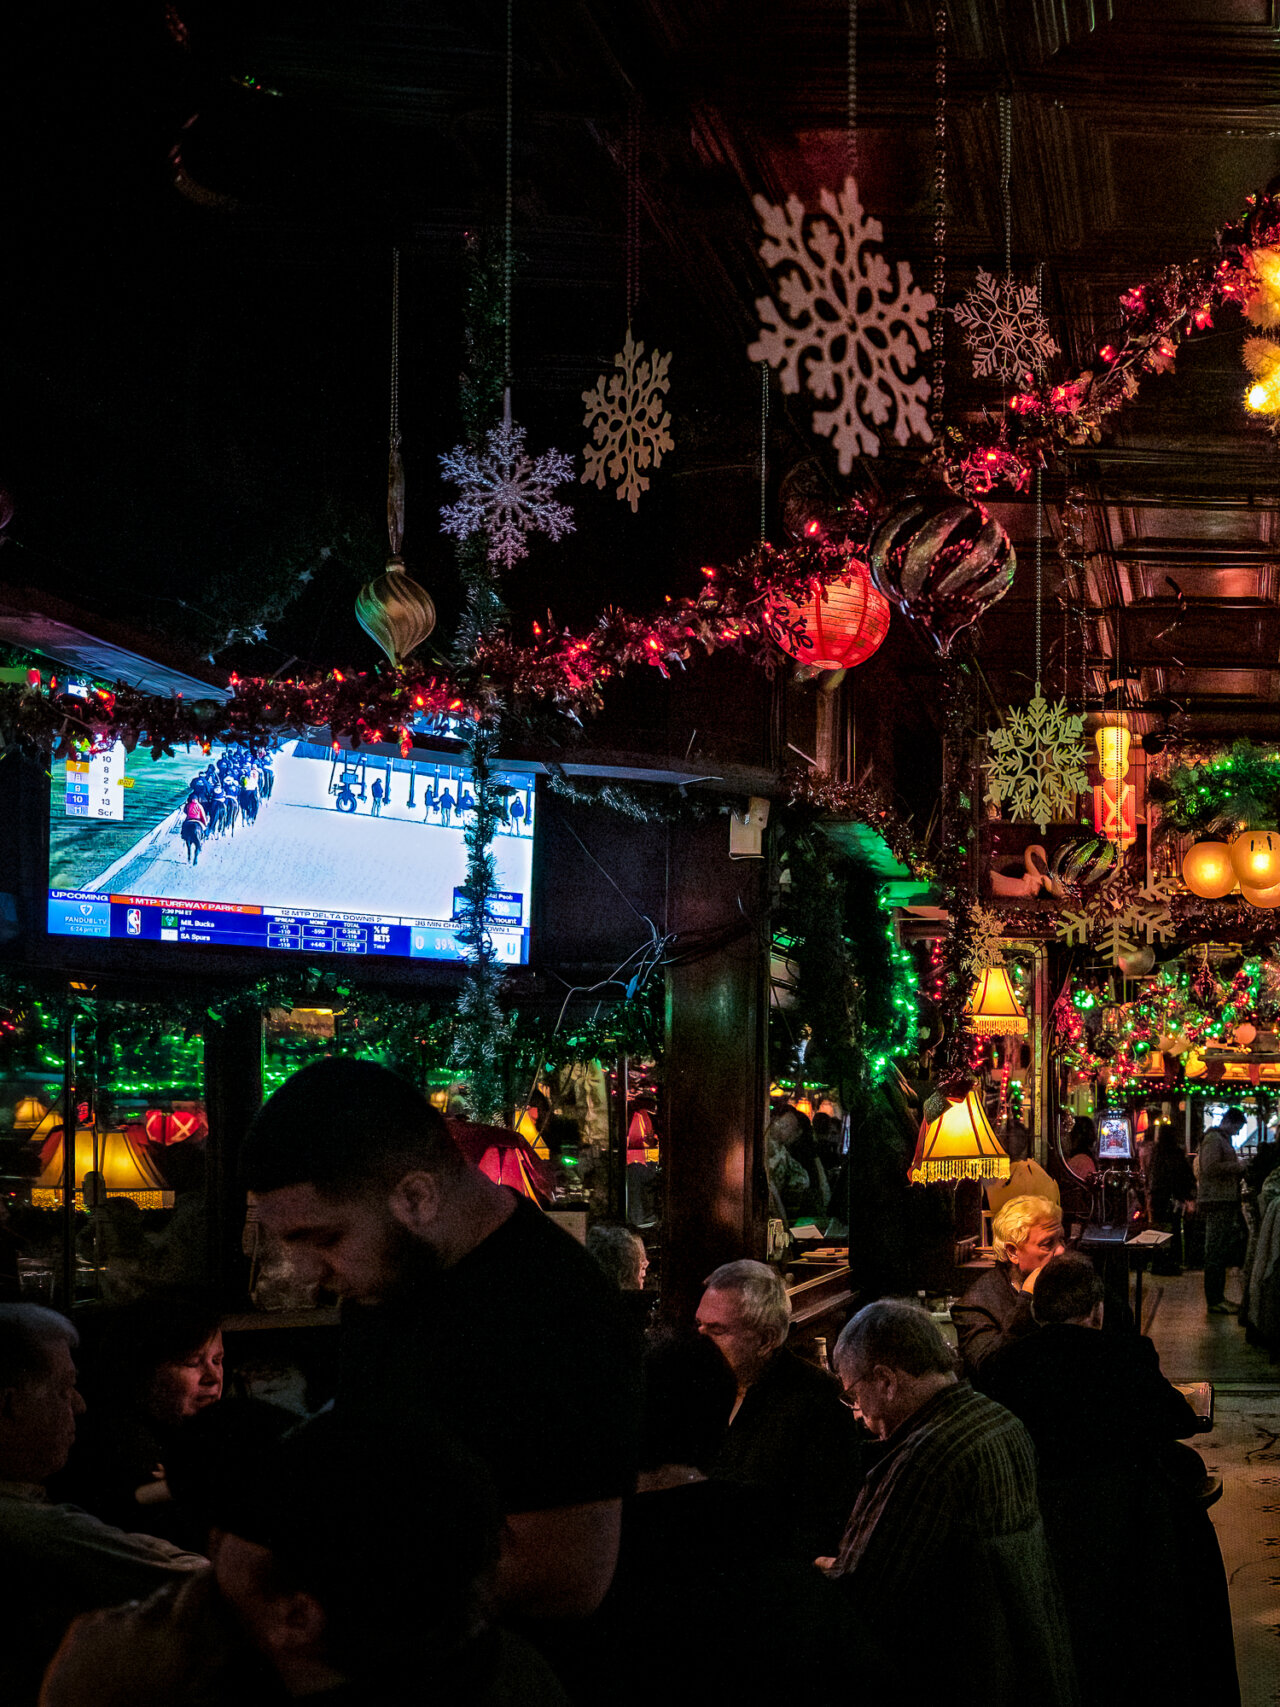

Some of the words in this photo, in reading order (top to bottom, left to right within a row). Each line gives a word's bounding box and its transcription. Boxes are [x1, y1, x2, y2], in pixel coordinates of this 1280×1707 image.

[73, 795, 83, 803] 10
[74, 806, 82, 814] 11
[97, 809, 114, 817] Scr
[51, 891, 109, 901] UPCOMING
[159, 899, 207, 910] TURFWAY
[207, 903, 235, 911] PARK
[194, 919, 215, 928] Bucks
[426, 921, 442, 929] MIN
[180, 932, 190, 940] SA
[191, 933, 211, 942] Spurs
[506, 942, 516, 956] U
